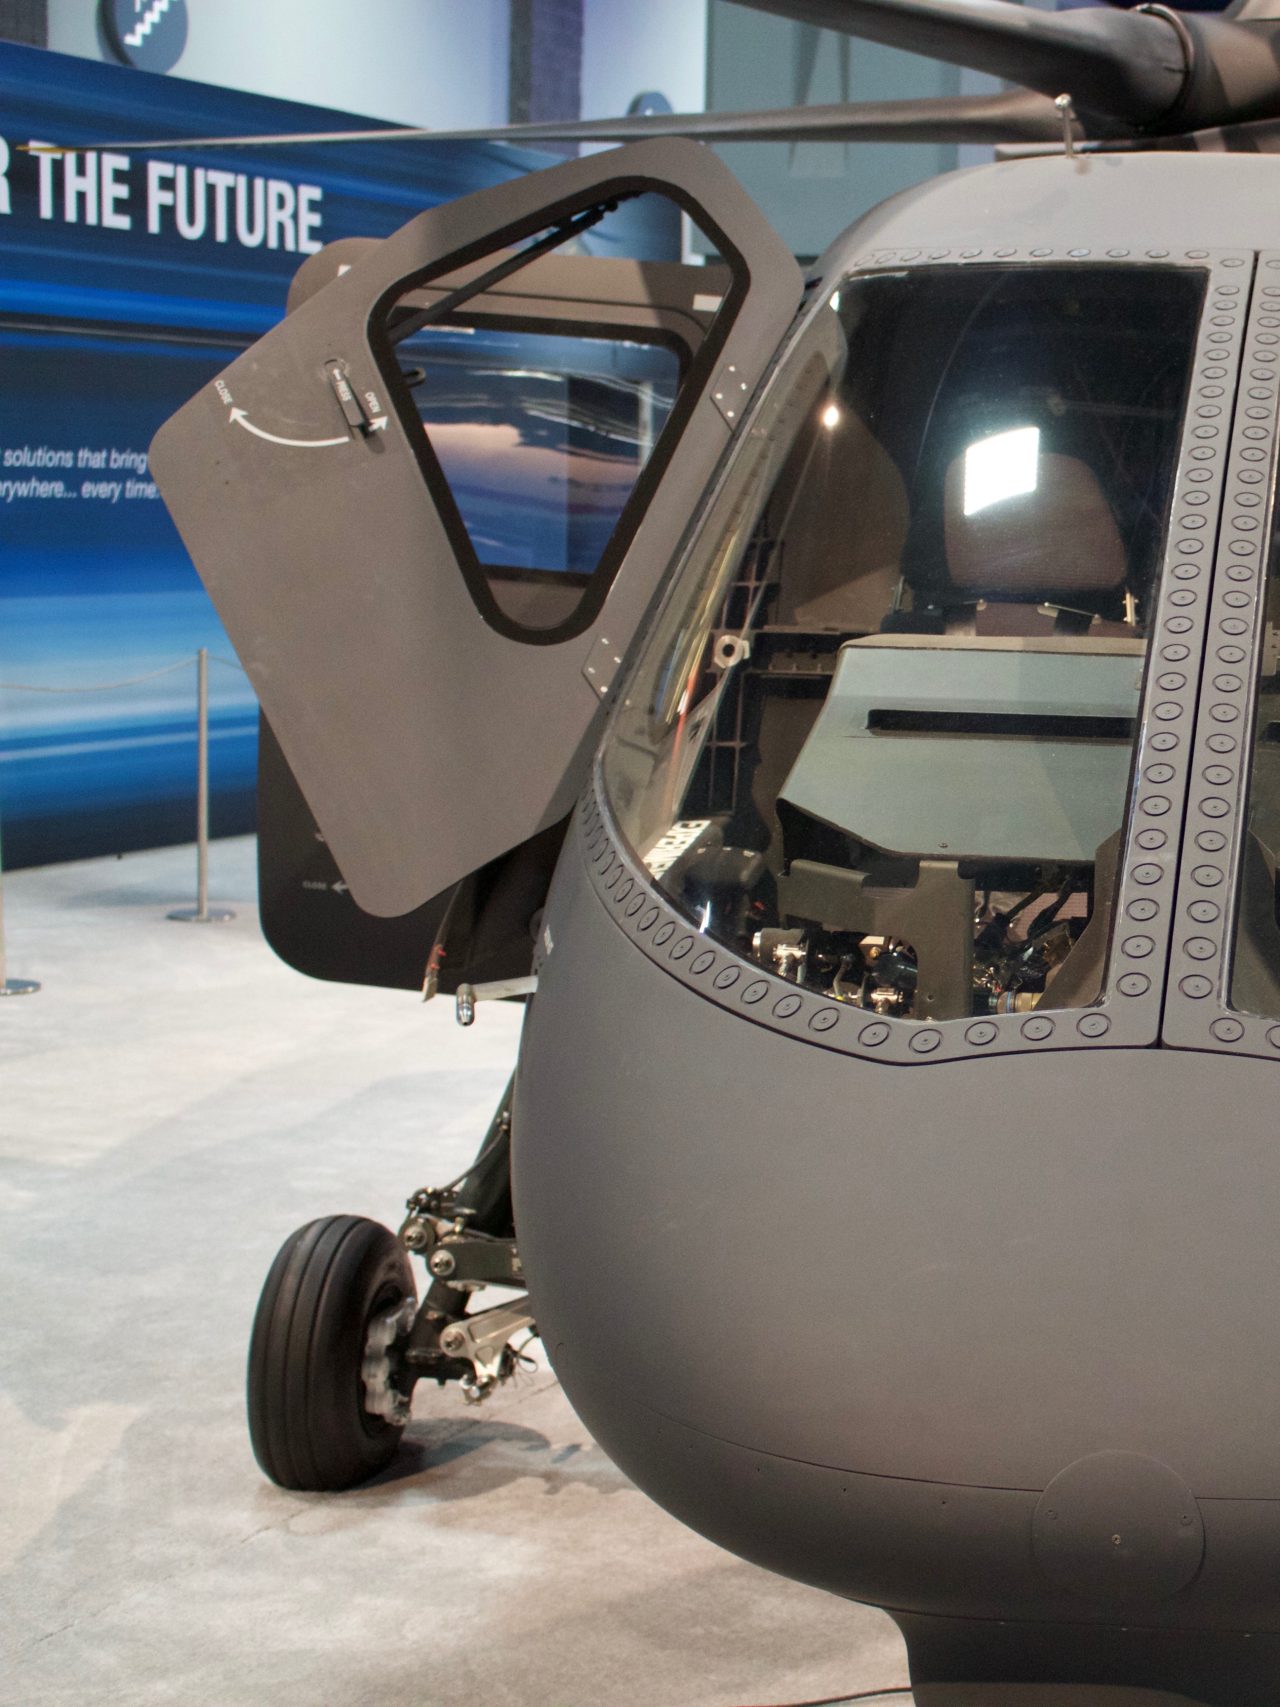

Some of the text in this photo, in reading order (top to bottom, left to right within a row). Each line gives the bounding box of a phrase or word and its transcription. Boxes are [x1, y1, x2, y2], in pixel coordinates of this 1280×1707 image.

[28, 139, 131, 231] THE
[147, 159, 324, 256] FUTURE
[214, 379, 234, 405] CLOSE
[364, 391, 382, 414] OPEN
[3, 445, 148, 475] solutions that bring
[81, 480, 122, 504] every
